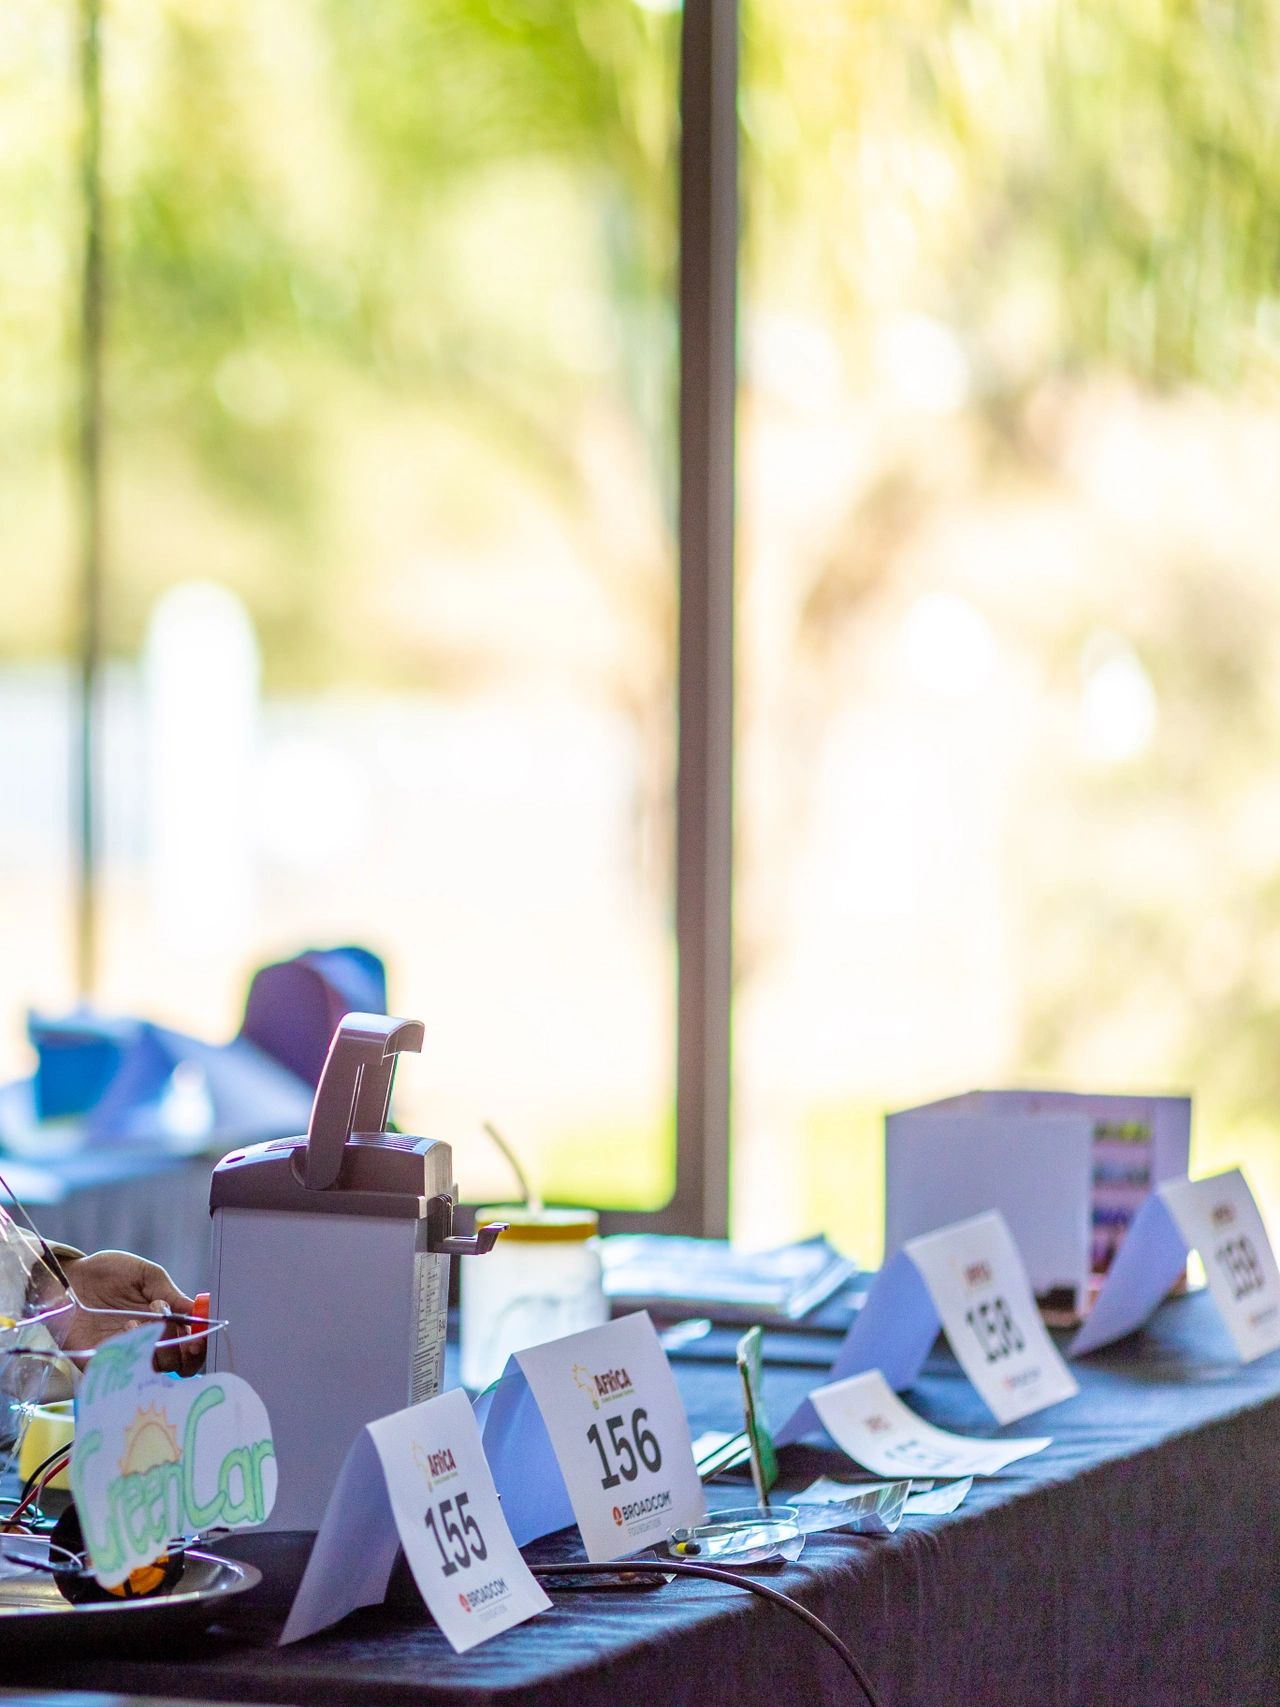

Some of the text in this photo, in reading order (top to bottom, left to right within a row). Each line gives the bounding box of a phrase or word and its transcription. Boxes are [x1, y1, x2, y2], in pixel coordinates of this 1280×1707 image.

[587, 1407, 662, 1490] 156
[424, 1491, 488, 1577] 155
[622, 1490, 671, 1521] BROADCOM
[467, 1577, 509, 1608] BROADCOM
